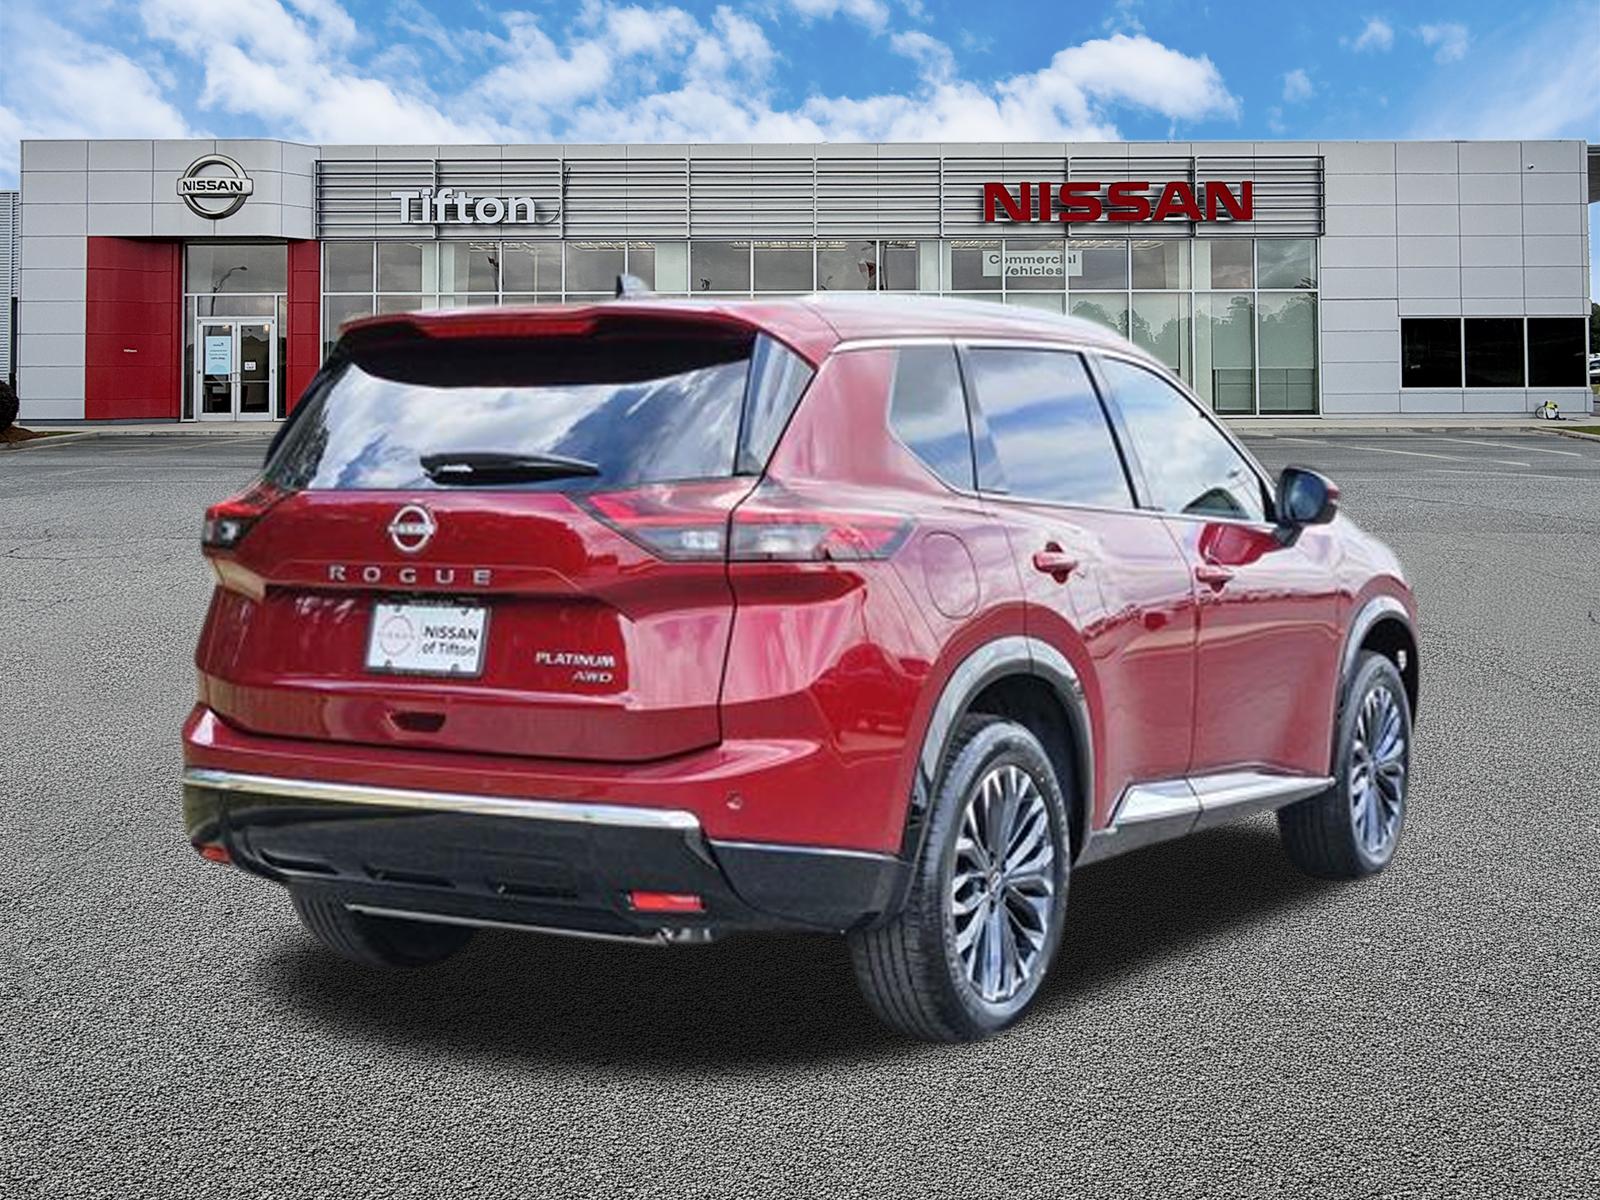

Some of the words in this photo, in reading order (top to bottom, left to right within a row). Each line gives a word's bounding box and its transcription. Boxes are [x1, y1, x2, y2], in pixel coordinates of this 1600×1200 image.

[182, 180, 244, 192] NISSAN
[390, 187, 537, 224] Tifton
[983, 181, 1253, 222] NISSAN
[328, 564, 492, 586] ROGUE
[423, 626, 479, 641] NISSAN
[422, 641, 437, 655] of
[438, 642, 477, 657] Tifton
[535, 651, 615, 668] PLATINUM
[571, 670, 614, 683] AWD
